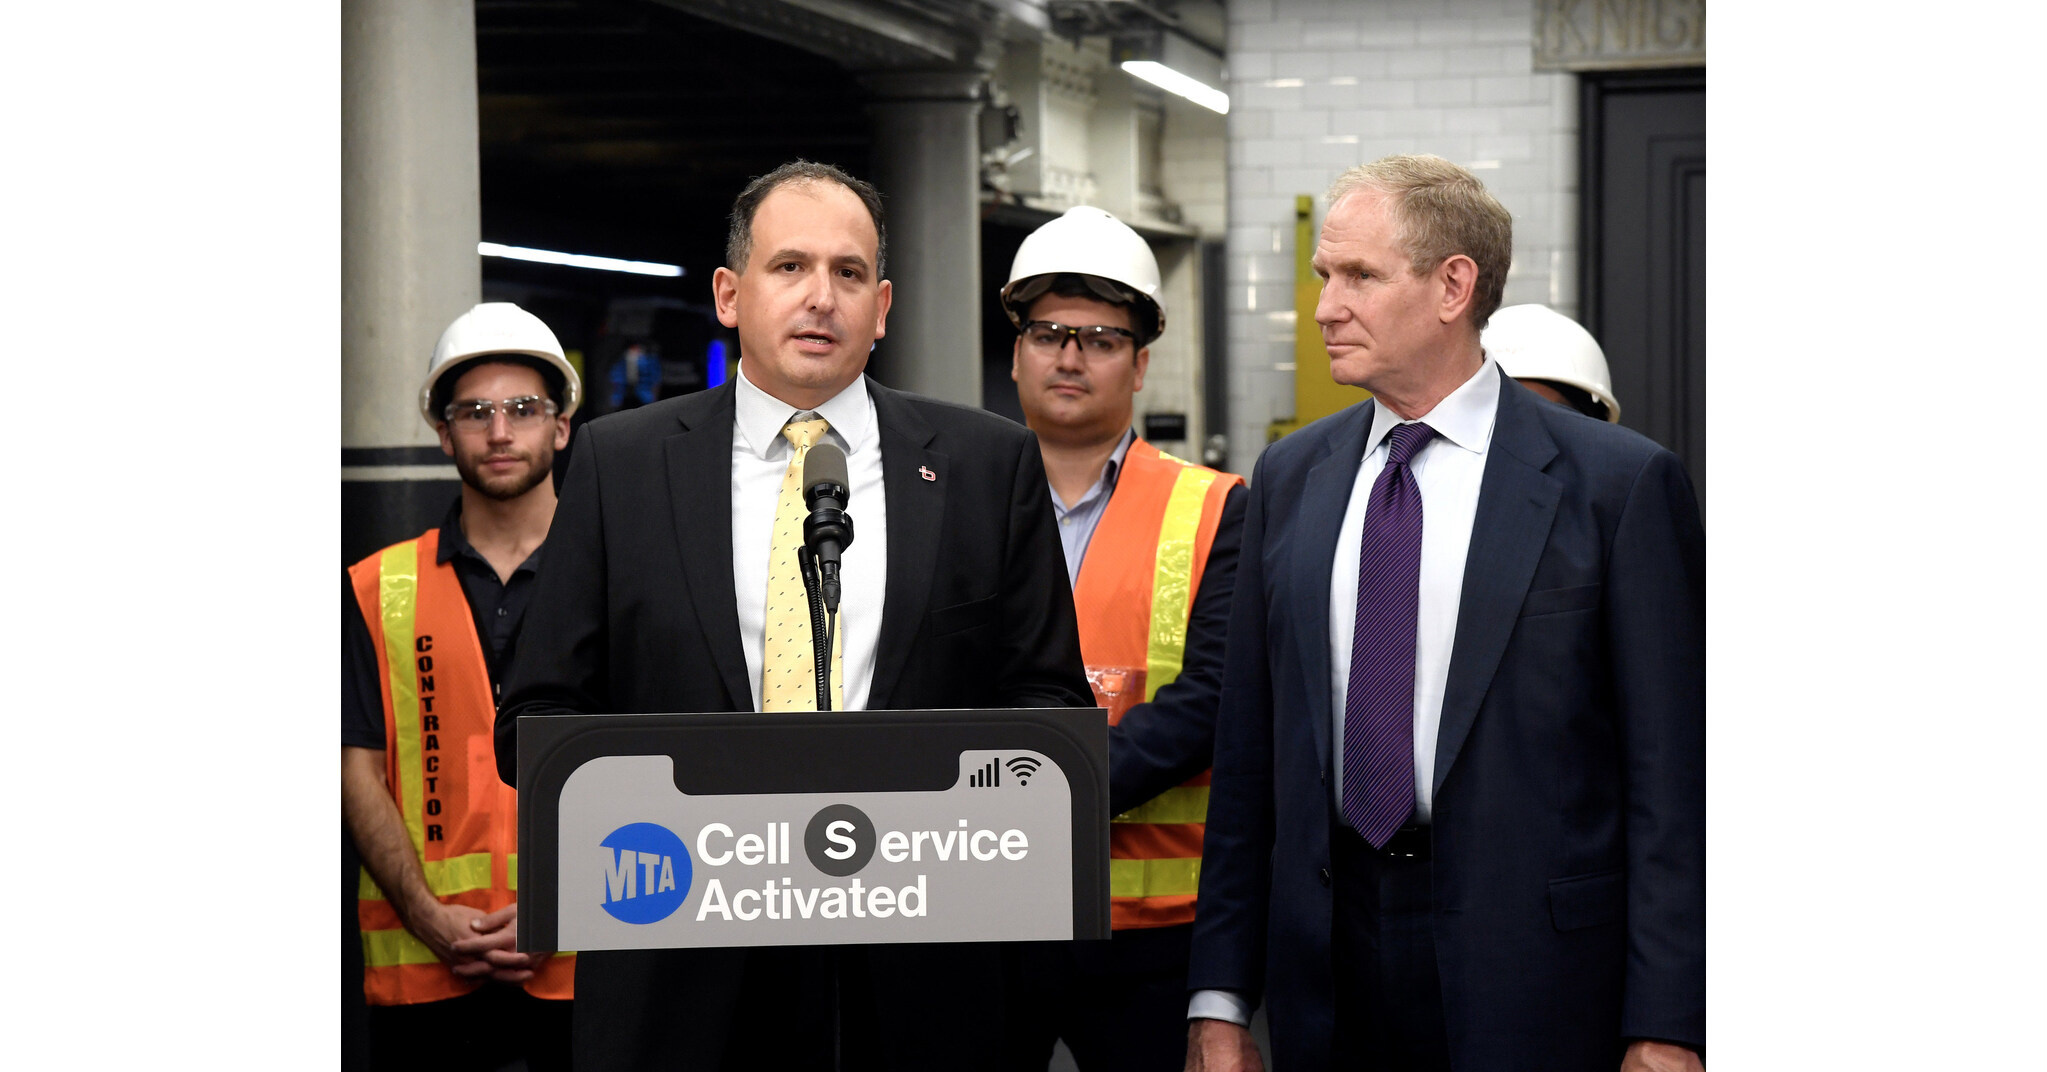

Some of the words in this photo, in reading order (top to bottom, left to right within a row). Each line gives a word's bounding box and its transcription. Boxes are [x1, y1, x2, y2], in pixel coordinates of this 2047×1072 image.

[416, 635, 443, 842] CONTRACTOR
[696, 822, 790, 866] Cell
[599, 845, 676, 905] MTA
[696, 874, 927, 922] Activated
